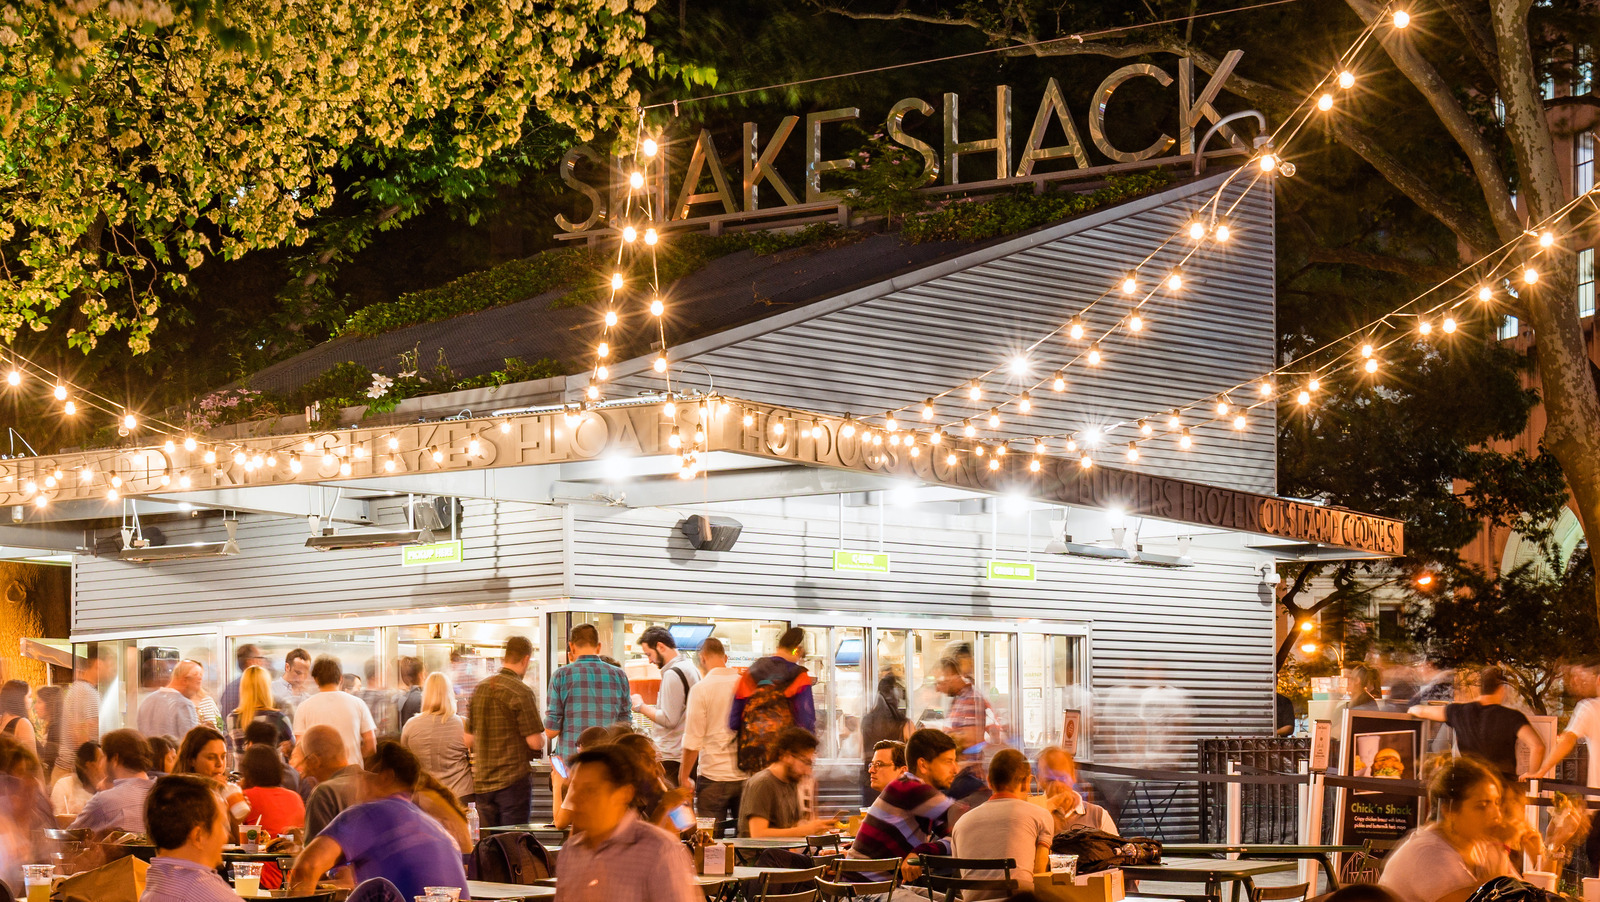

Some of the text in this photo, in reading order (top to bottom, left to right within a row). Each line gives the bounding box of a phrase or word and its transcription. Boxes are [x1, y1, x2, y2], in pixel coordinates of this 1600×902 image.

[553, 49, 1248, 233] SHAKE SHACK
[1183, 483, 1259, 531] FROZEN
[1351, 802, 1412, 815] Chick'n Shack
